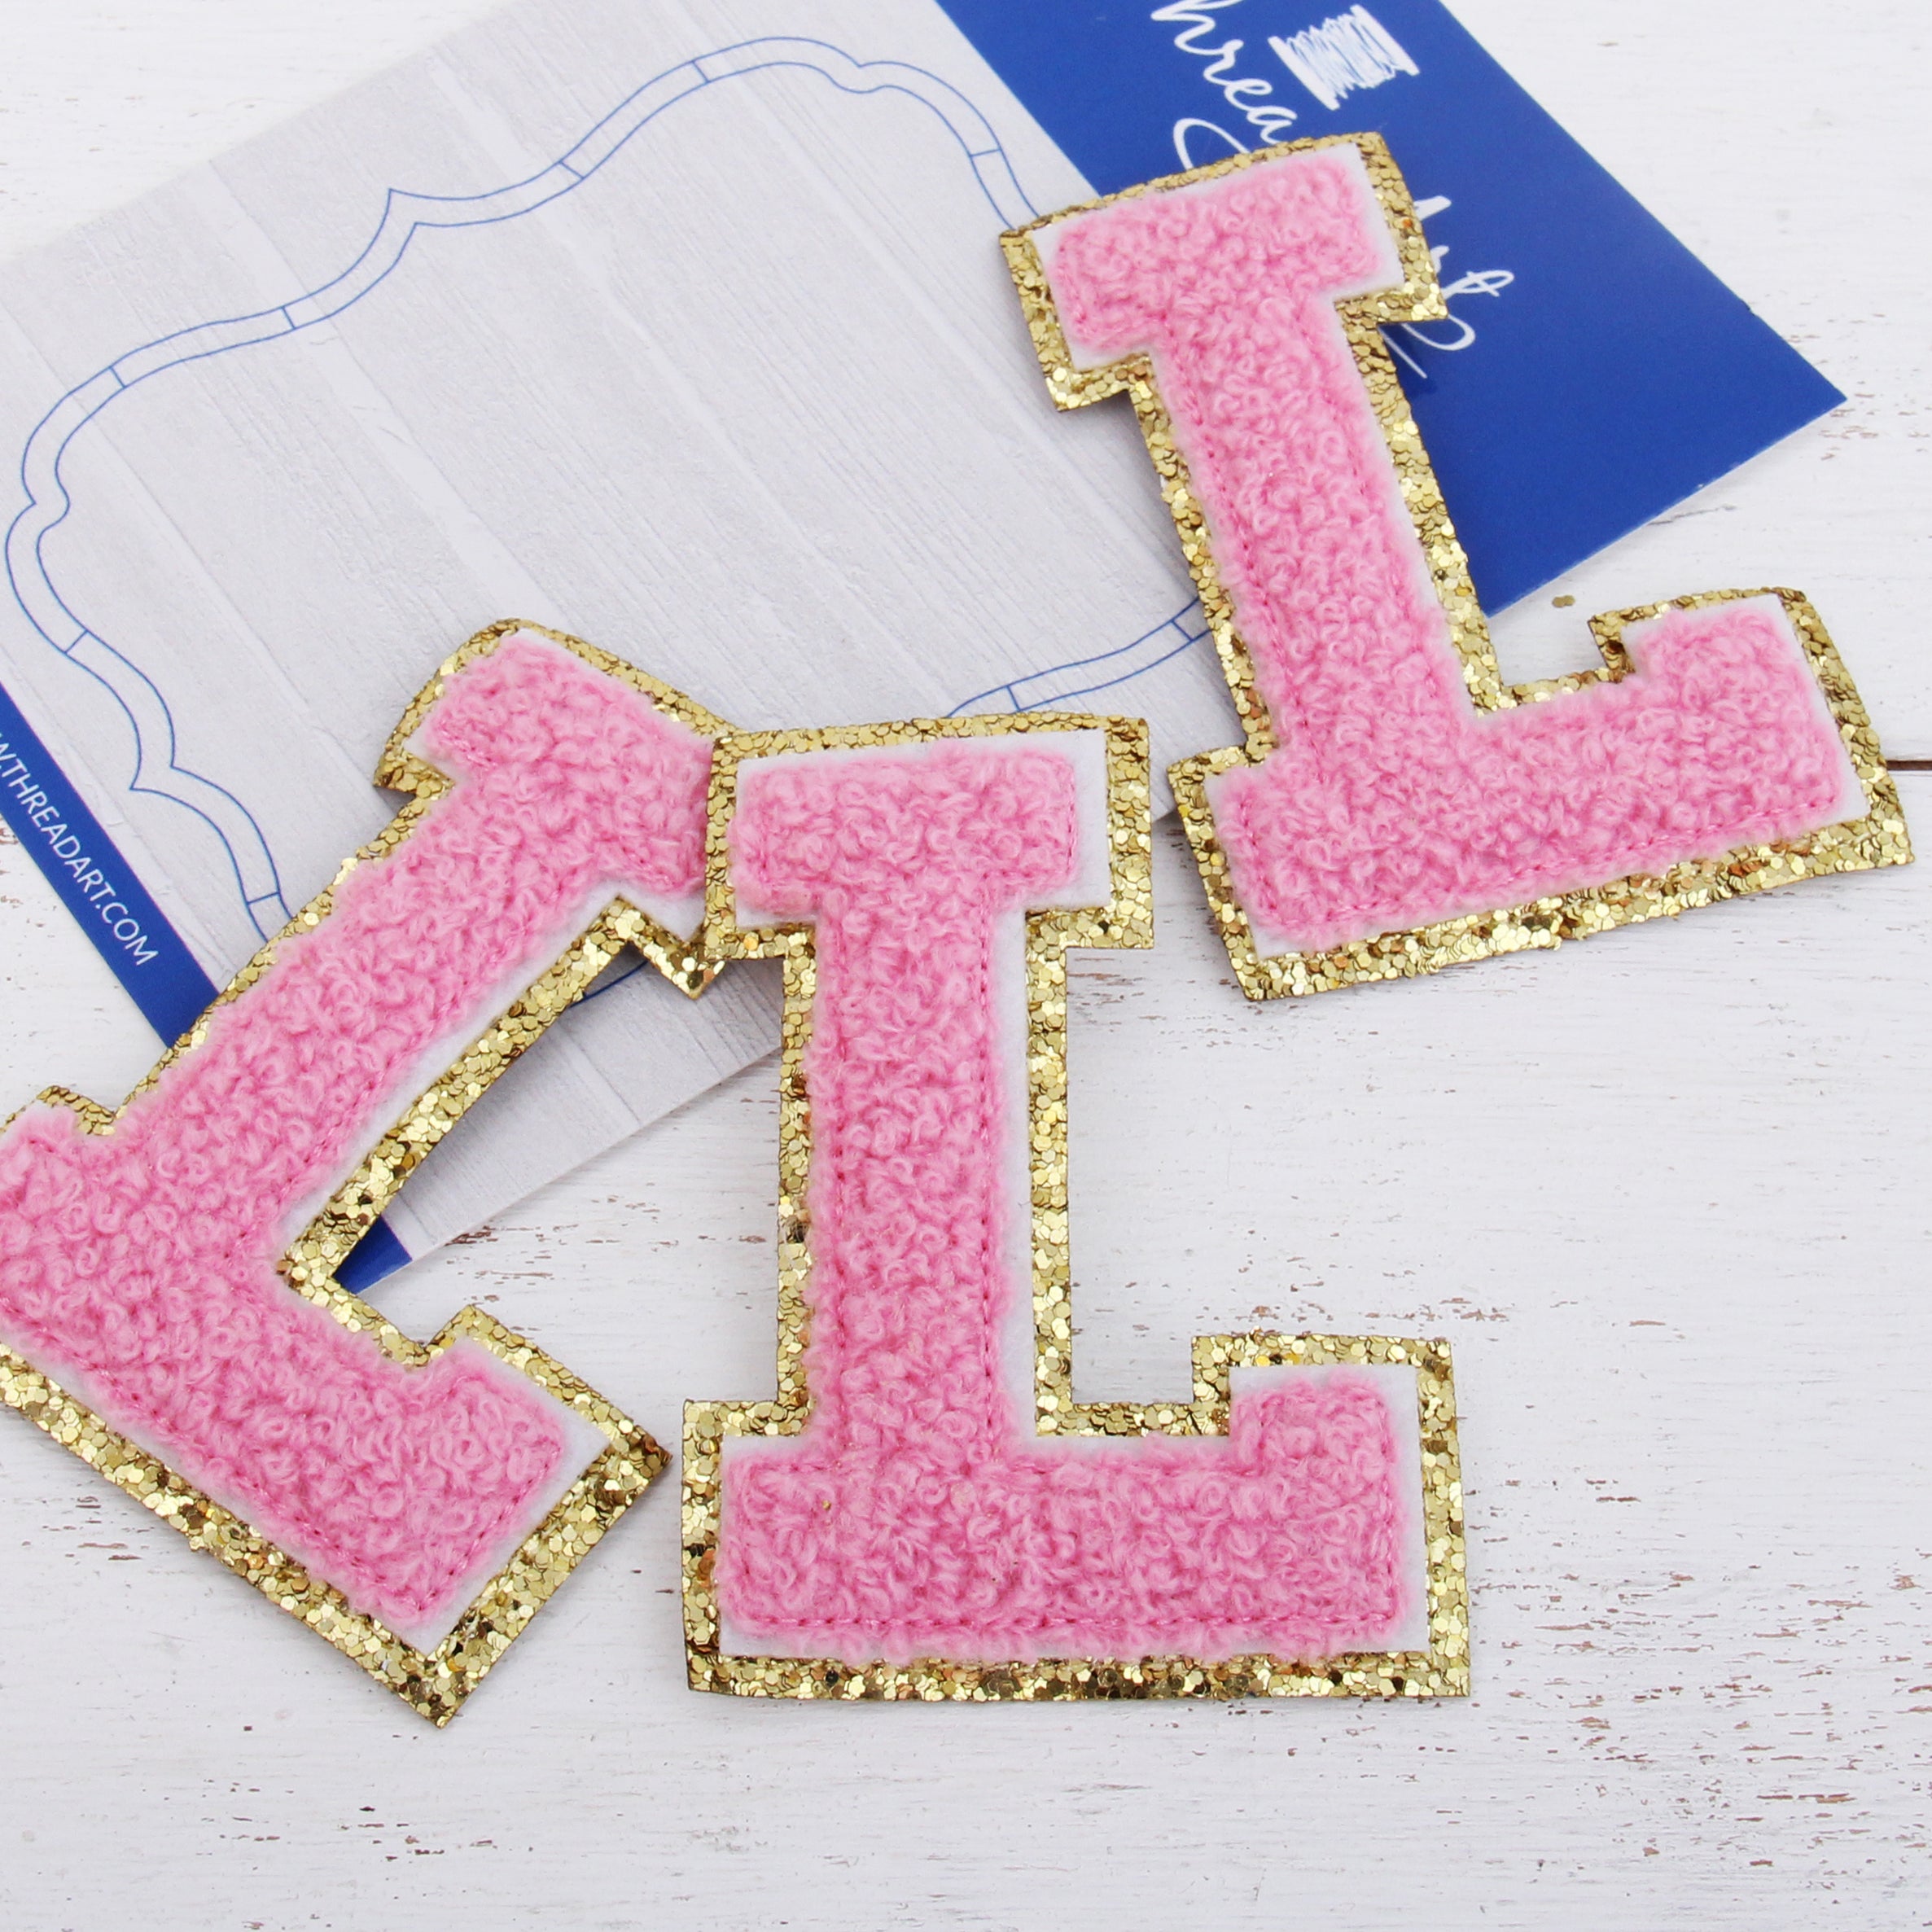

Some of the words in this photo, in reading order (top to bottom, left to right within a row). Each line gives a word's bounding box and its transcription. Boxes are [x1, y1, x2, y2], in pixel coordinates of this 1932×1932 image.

[0, 742, 159, 966] THREADART.COM
[1001, 132, 1912, 1001] L
[682, 712, 1471, 1704] L
